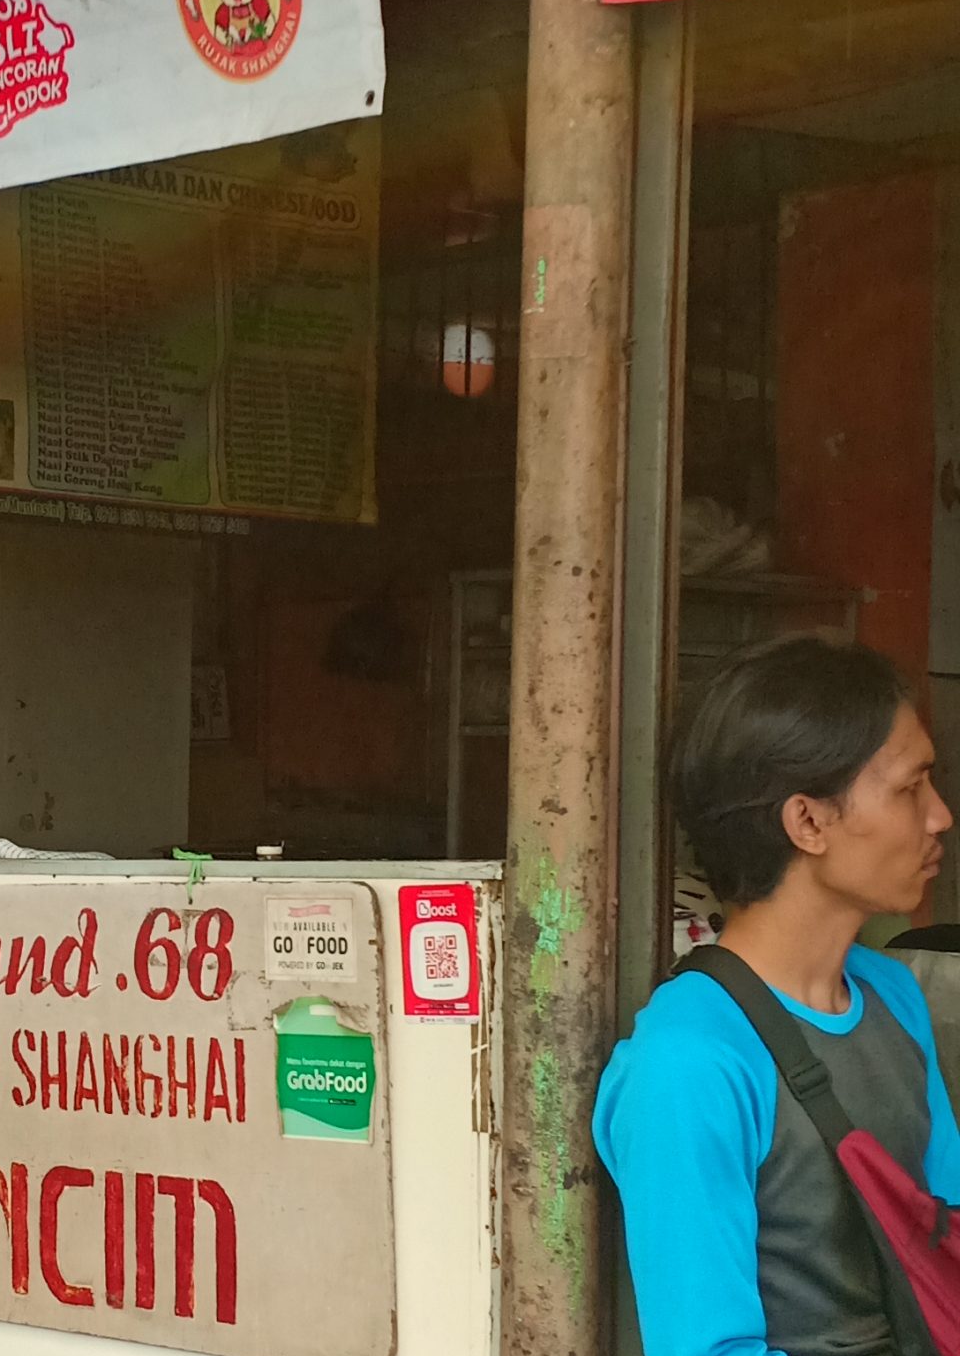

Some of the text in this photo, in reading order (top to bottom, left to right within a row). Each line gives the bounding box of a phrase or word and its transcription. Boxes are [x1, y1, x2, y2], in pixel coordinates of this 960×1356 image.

[197, 11, 298, 75] RUJAK SHANGHAI
[182, 175, 223, 202] DAN
[293, 921, 336, 933] AVAILABLE
[273, 935, 349, 955] GO FOOD
[11, 1028, 246, 1124] SHANGHAI
[286, 1068, 368, 1094] GrabFood
